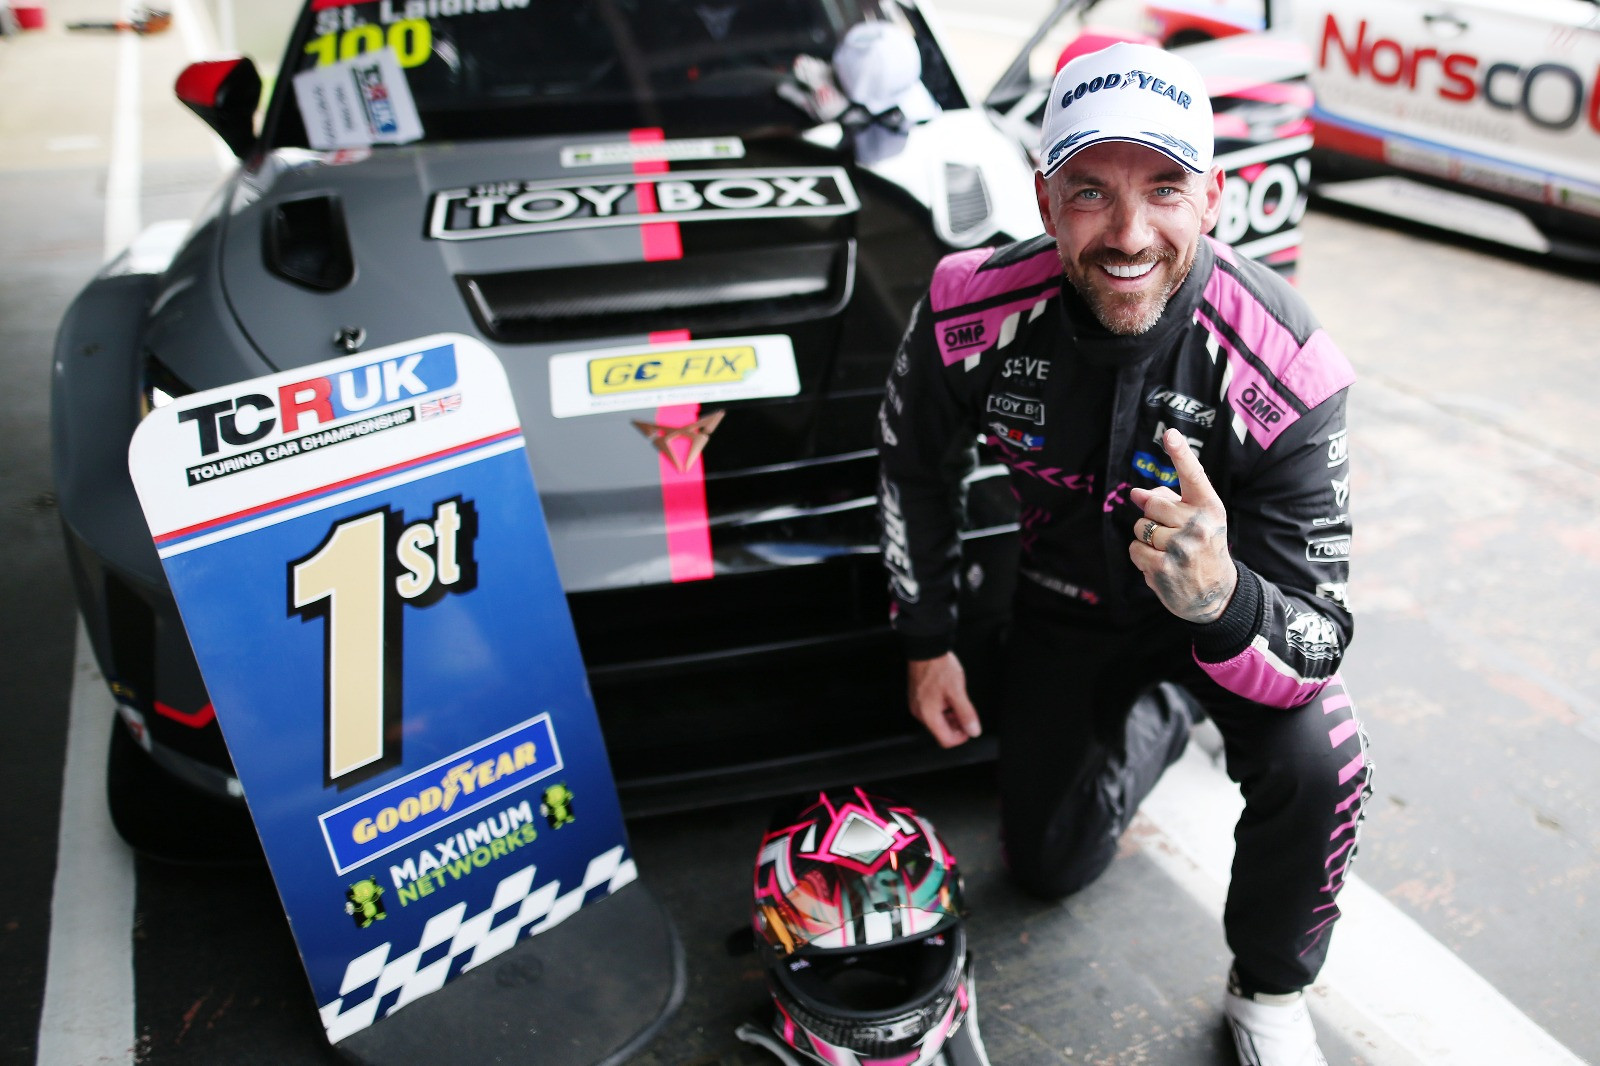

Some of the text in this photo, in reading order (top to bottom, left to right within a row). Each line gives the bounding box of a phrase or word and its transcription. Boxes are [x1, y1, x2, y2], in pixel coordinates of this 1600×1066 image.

[304, 18, 432, 68] 100
[465, 176, 829, 227] TOY BOX
[944, 325, 985, 347] OMP
[602, 354, 744, 386] GC FIX
[1241, 388, 1282, 426] OMP
[190, 409, 413, 482] TOURING CAR CHAMPIONSHIP
[289, 498, 466, 783] 1st
[389, 799, 534, 889] MAXIMUM
[397, 821, 538, 908] NETWORKS
